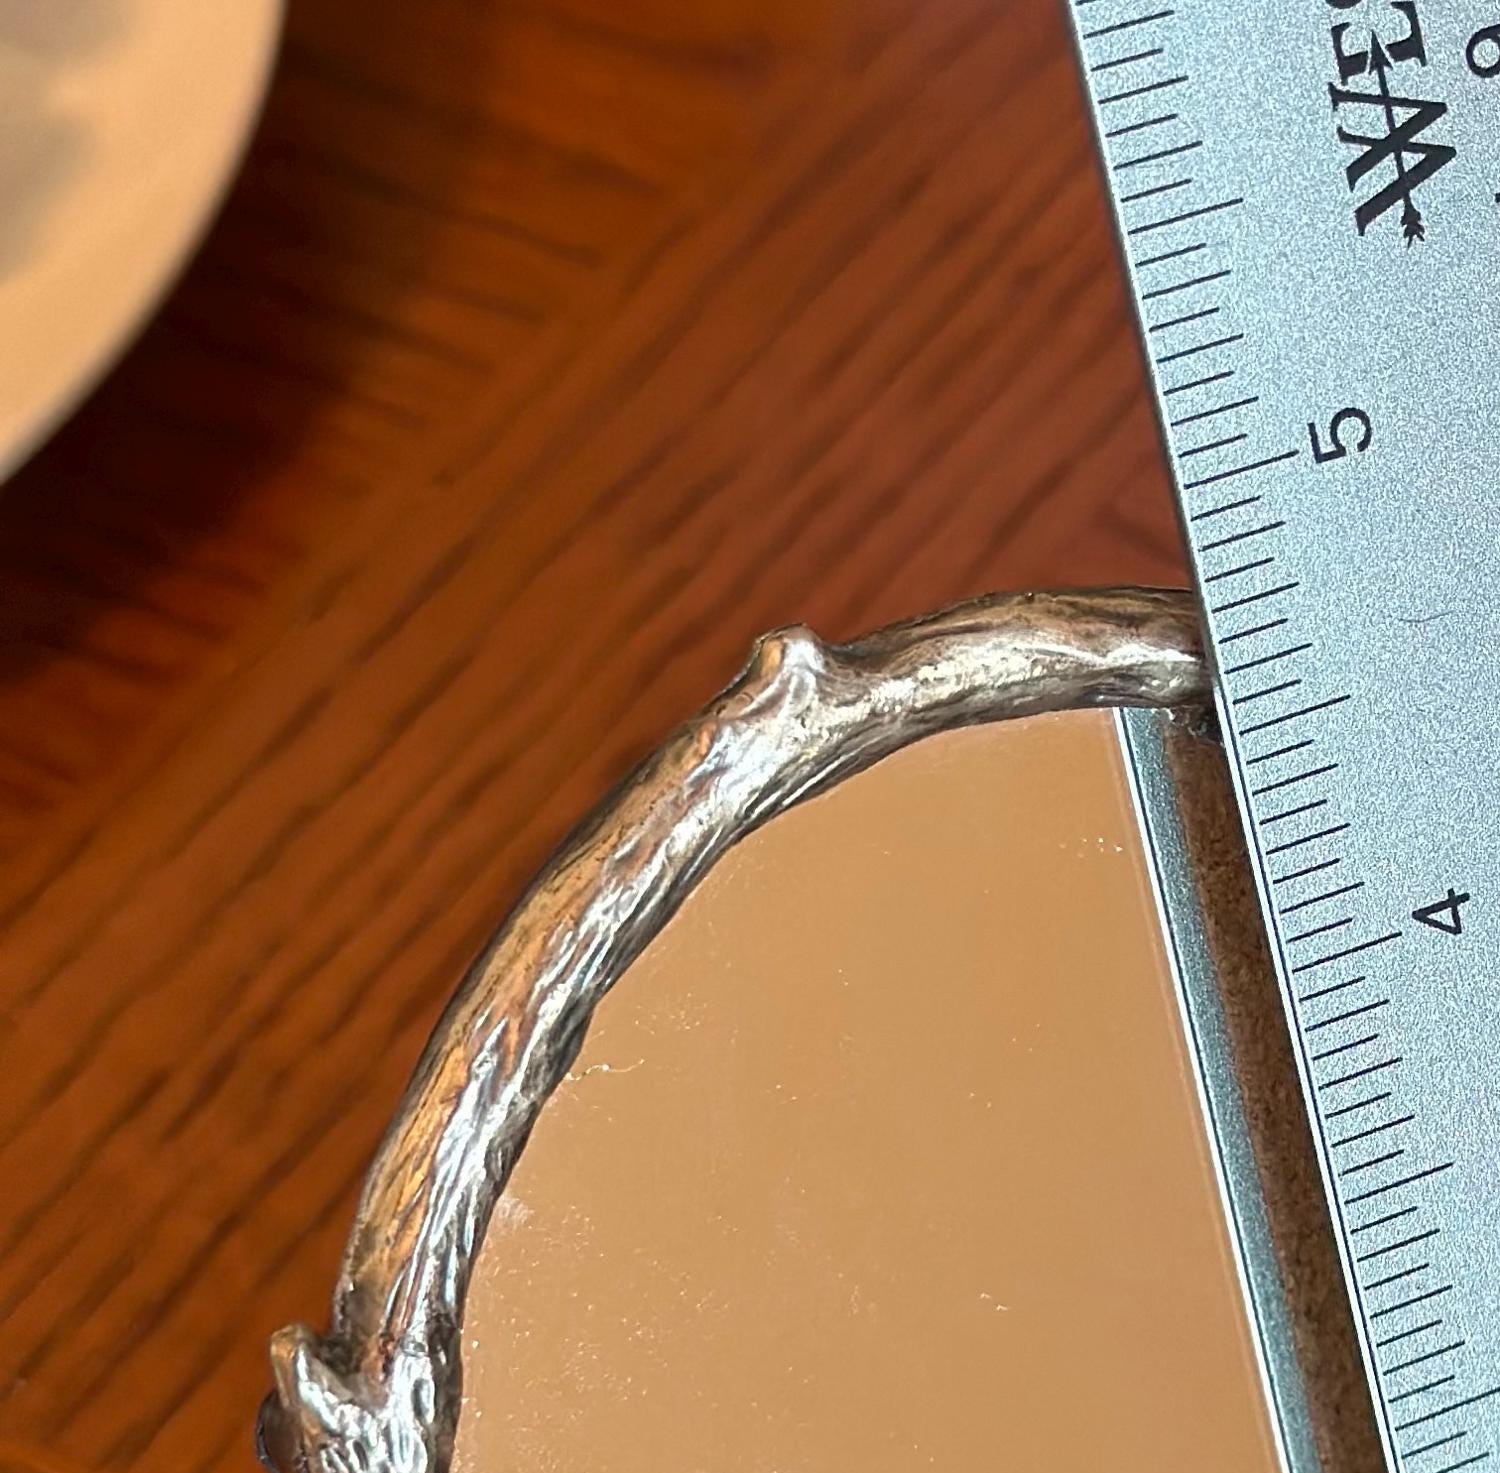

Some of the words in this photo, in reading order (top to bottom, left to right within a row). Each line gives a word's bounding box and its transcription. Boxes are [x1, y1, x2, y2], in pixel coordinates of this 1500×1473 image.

[1325, 0, 1457, 238] WE
[1307, 406, 1373, 465] 5
[1411, 887, 1471, 936] 4
